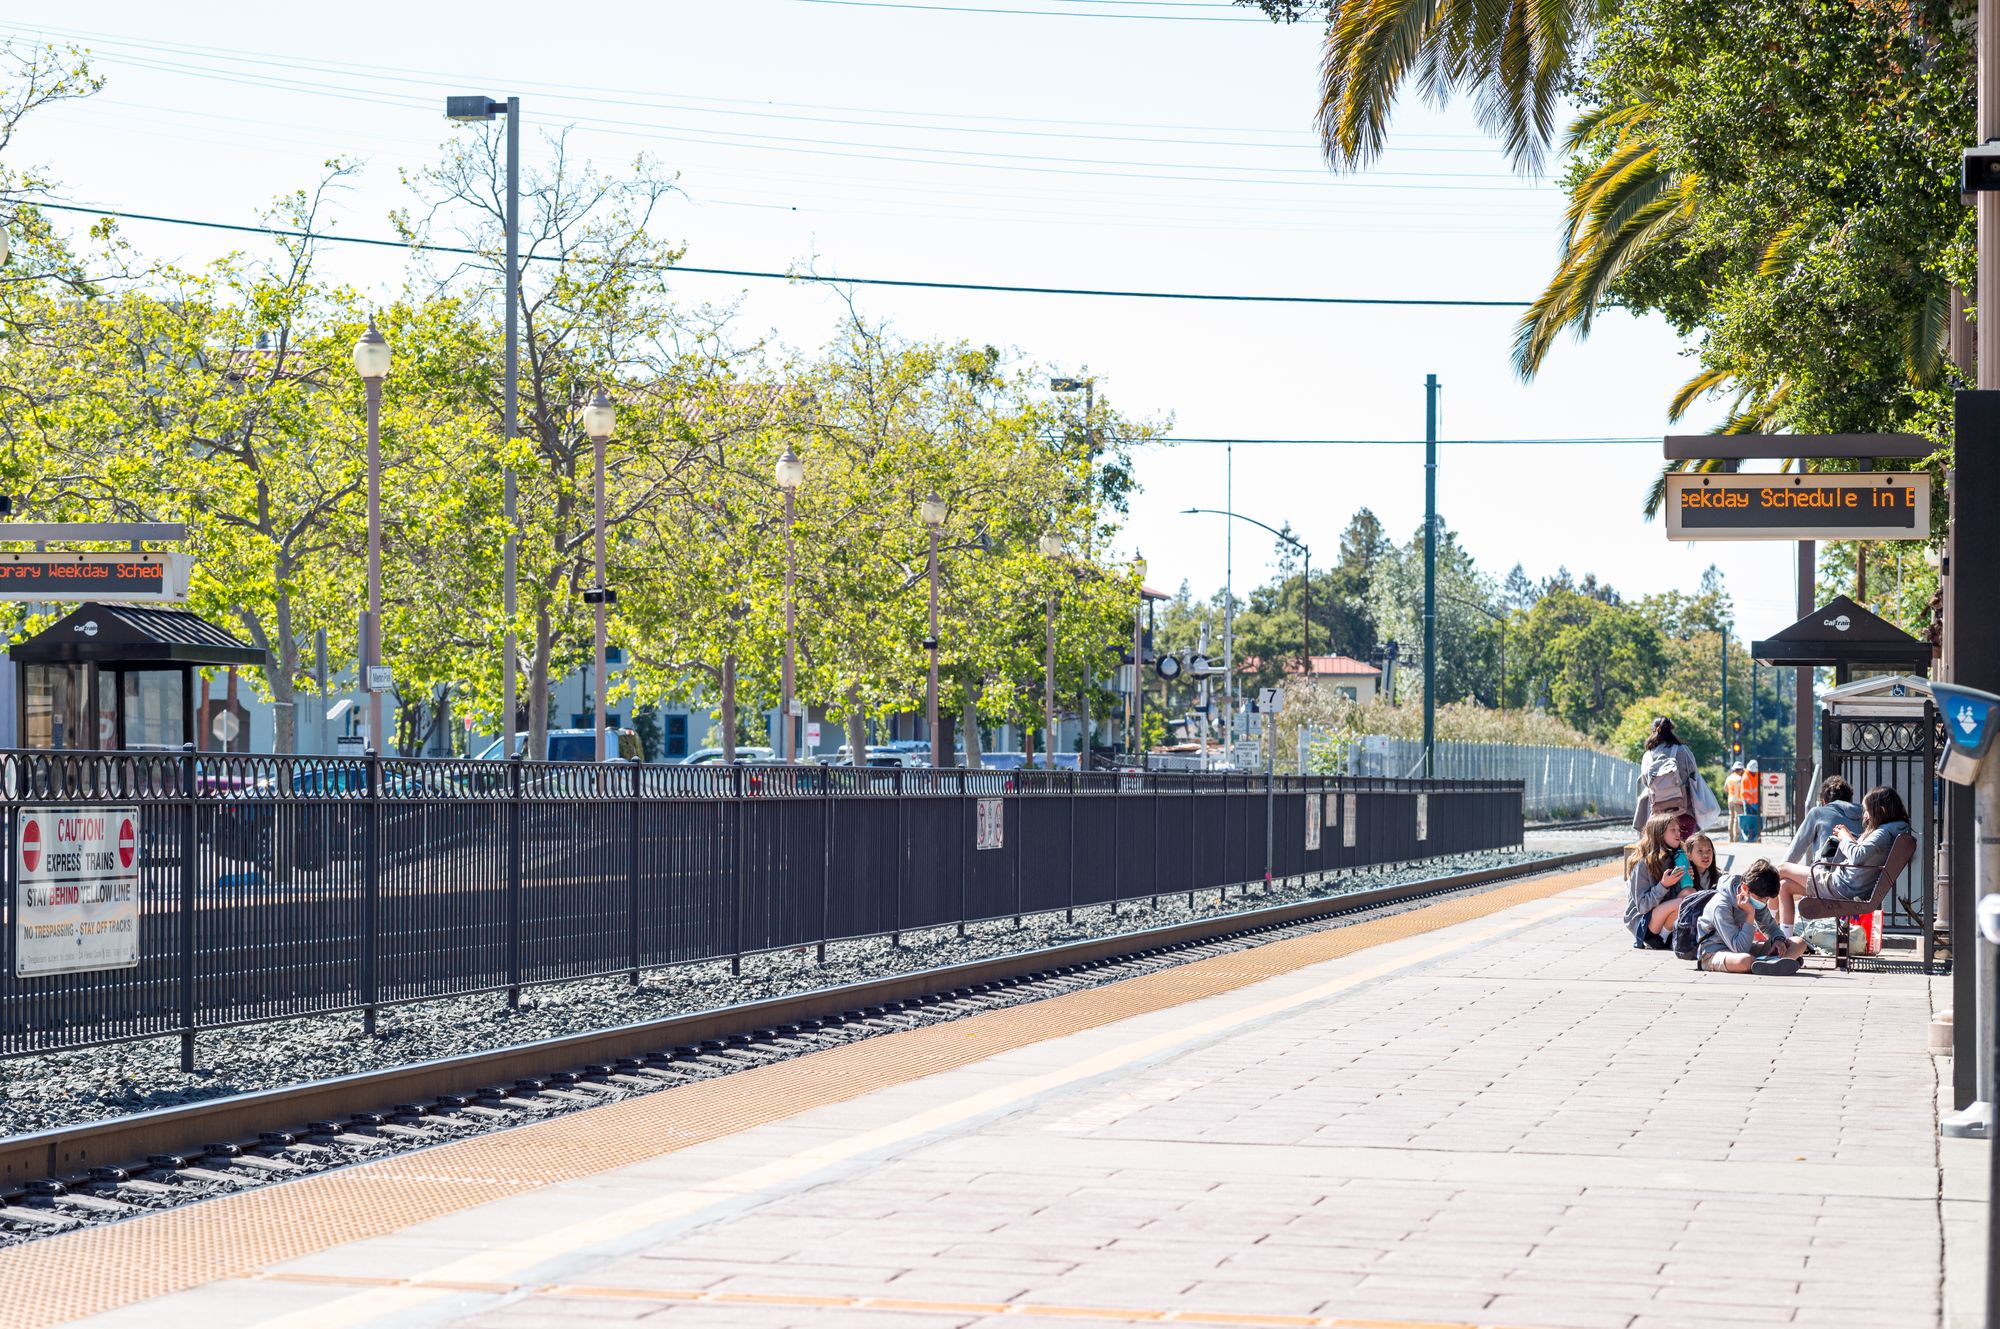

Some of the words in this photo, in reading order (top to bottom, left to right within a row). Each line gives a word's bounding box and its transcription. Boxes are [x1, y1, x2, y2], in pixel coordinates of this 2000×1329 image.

[1761, 487, 1858, 508] Schedule
[1872, 487, 1895, 508] in
[48, 563, 109, 578] Weekday
[58, 818, 104, 842] CAUTION!
[47, 854, 81, 872] EXPRESS
[86, 852, 114, 871] TRAINS
[27, 887, 48, 908] STAY
[49, 885, 79, 907] BEHIND
[80, 884, 113, 905] YELLOW
[114, 884, 131, 901] LINE
[24, 925, 34, 940] NO
[35, 925, 74, 939] TRESPASSING
[79, 921, 95, 936] STAY
[96, 921, 109, 935] OFF
[109, 918, 133, 934] TRACKS!
